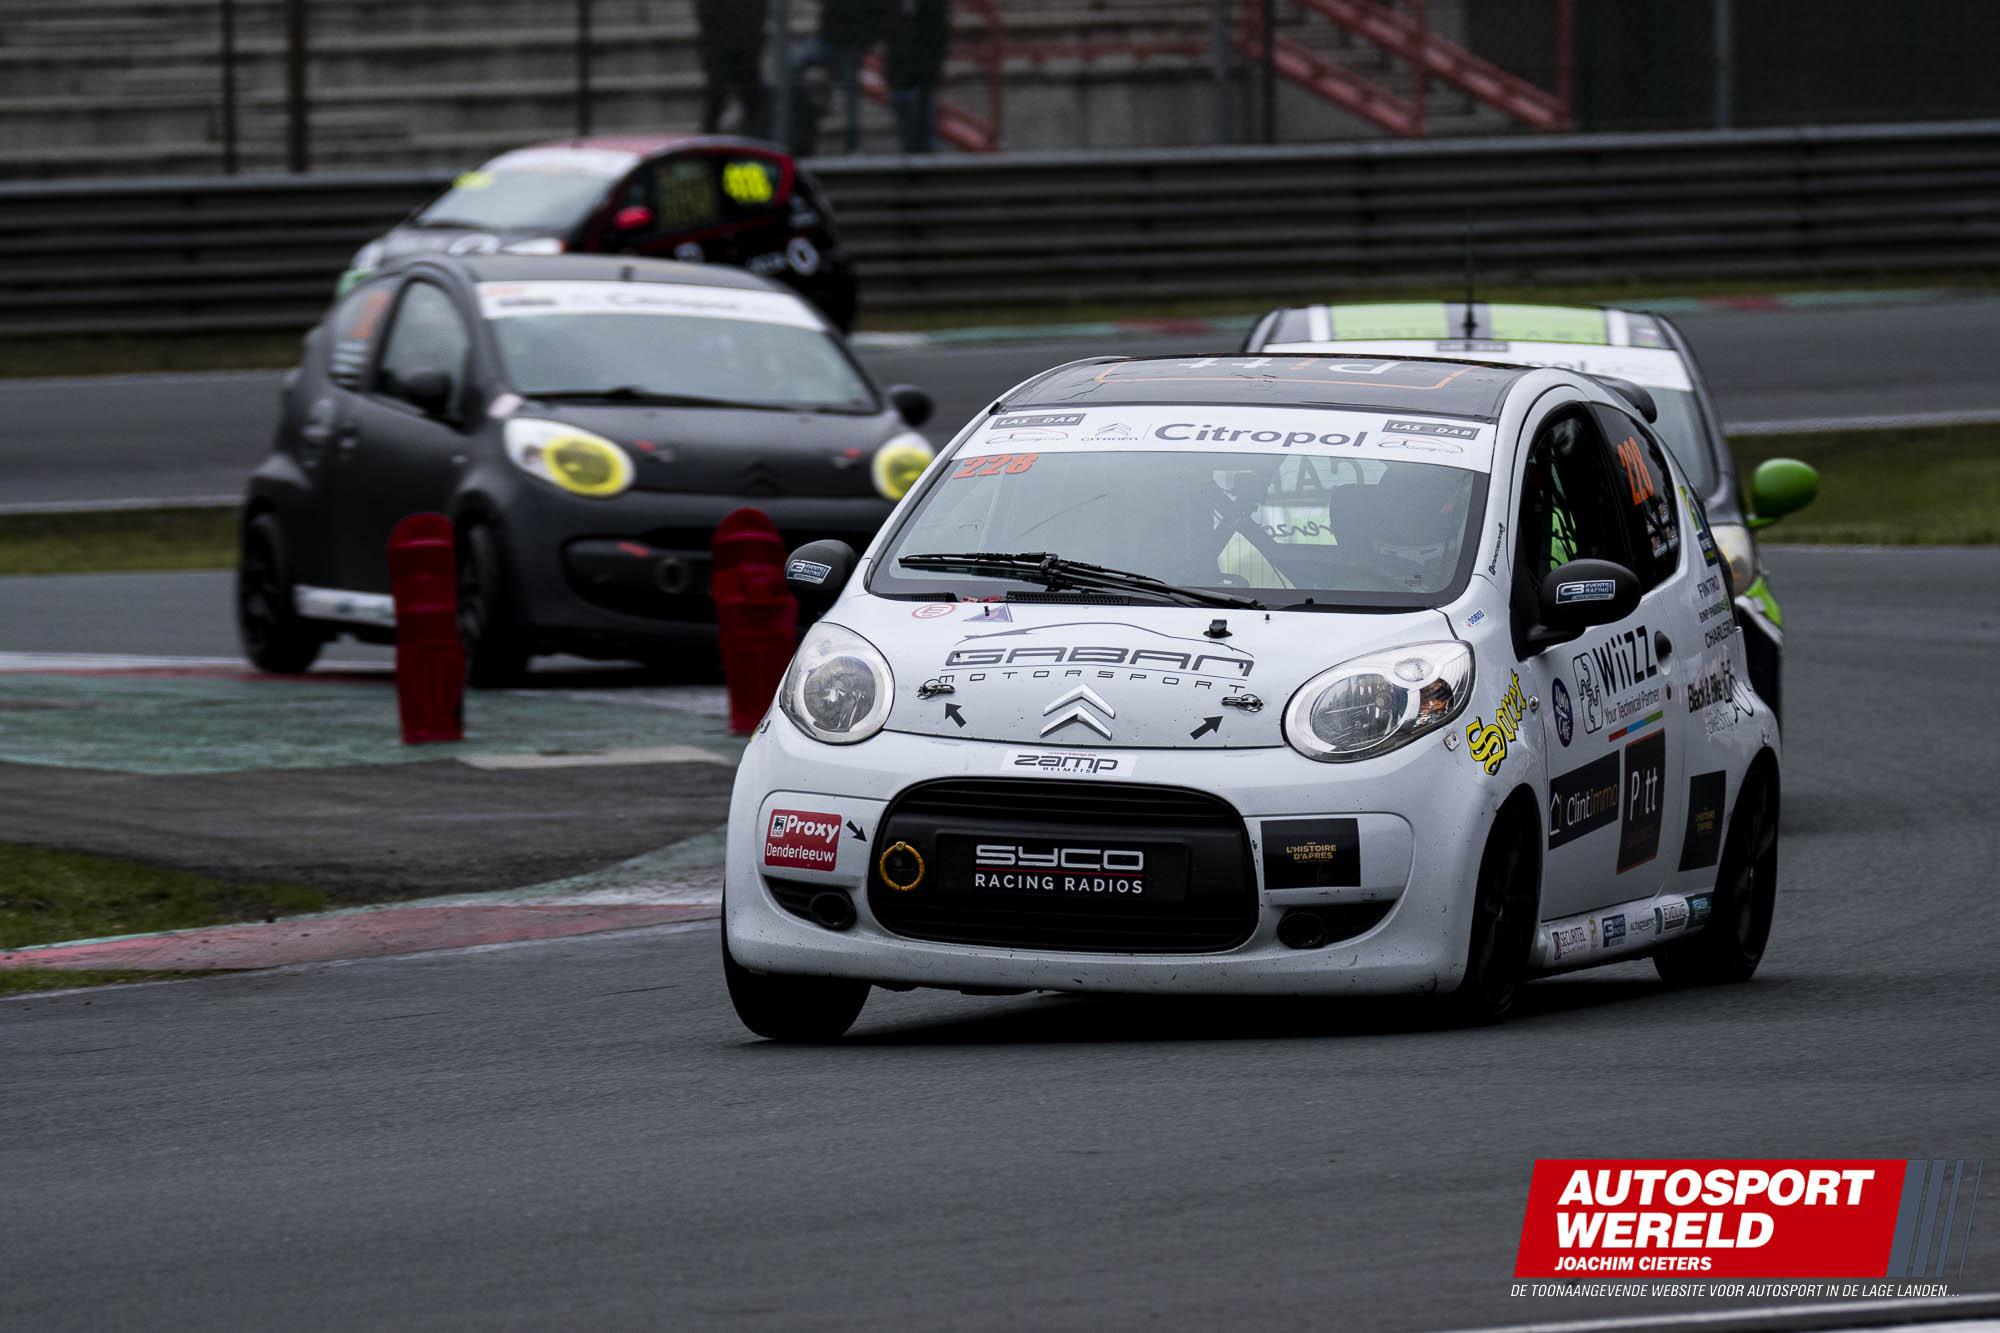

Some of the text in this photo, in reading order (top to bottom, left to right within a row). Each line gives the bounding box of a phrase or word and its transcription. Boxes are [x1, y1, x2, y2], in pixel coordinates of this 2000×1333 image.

[1155, 422, 1368, 448] Citropol
[952, 453, 1039, 479] 228
[939, 669, 1246, 694] MOTORSPORT
[1617, 693, 1641, 719] Technical
[1014, 754, 1119, 774] zamp
[785, 814, 840, 843] Proxy
[766, 842, 835, 863] Denderleeuw
[975, 844, 1144, 871] SYCO
[975, 874, 1143, 894] RACING RADIOS
